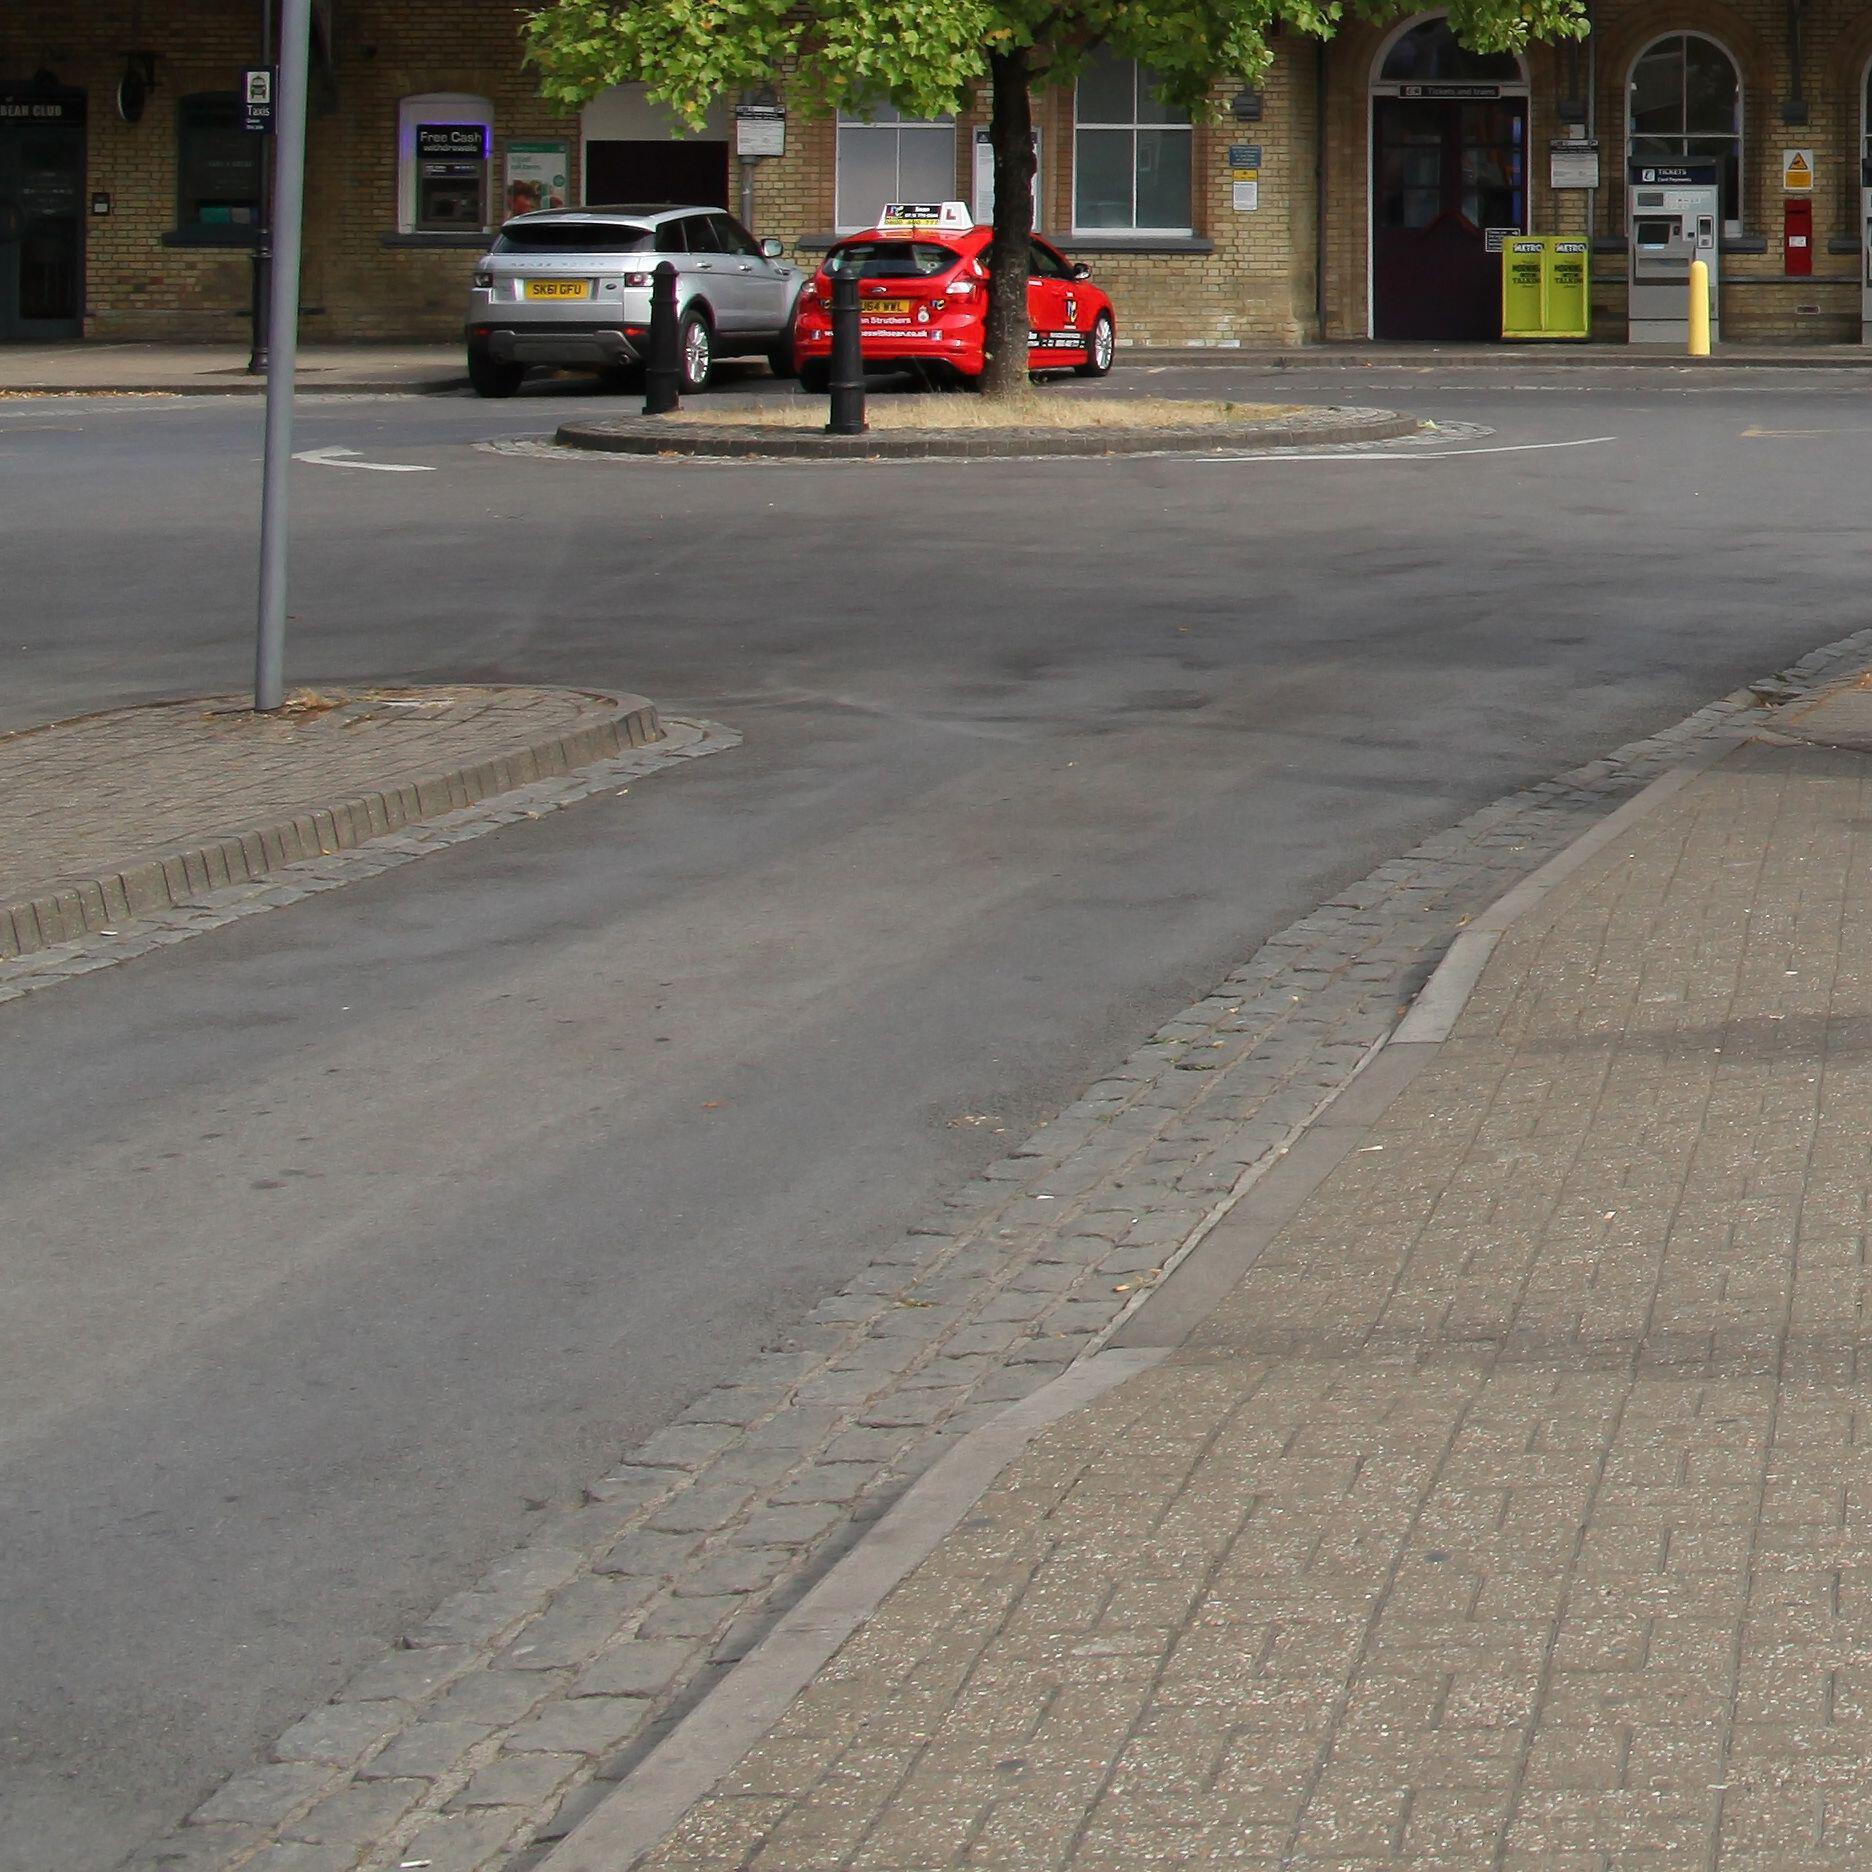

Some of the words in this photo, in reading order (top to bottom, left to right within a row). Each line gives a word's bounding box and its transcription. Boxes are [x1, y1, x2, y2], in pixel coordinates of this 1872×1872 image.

[247, 105, 270, 117] Taxis
[420, 131, 447, 143] Free
[451, 131, 482, 143] Cash
[1658, 168, 1687, 176] TICKETS
[946, 209, 956, 220] L
[533, 284, 557, 295] SK61
[560, 284, 582, 295] GFU
